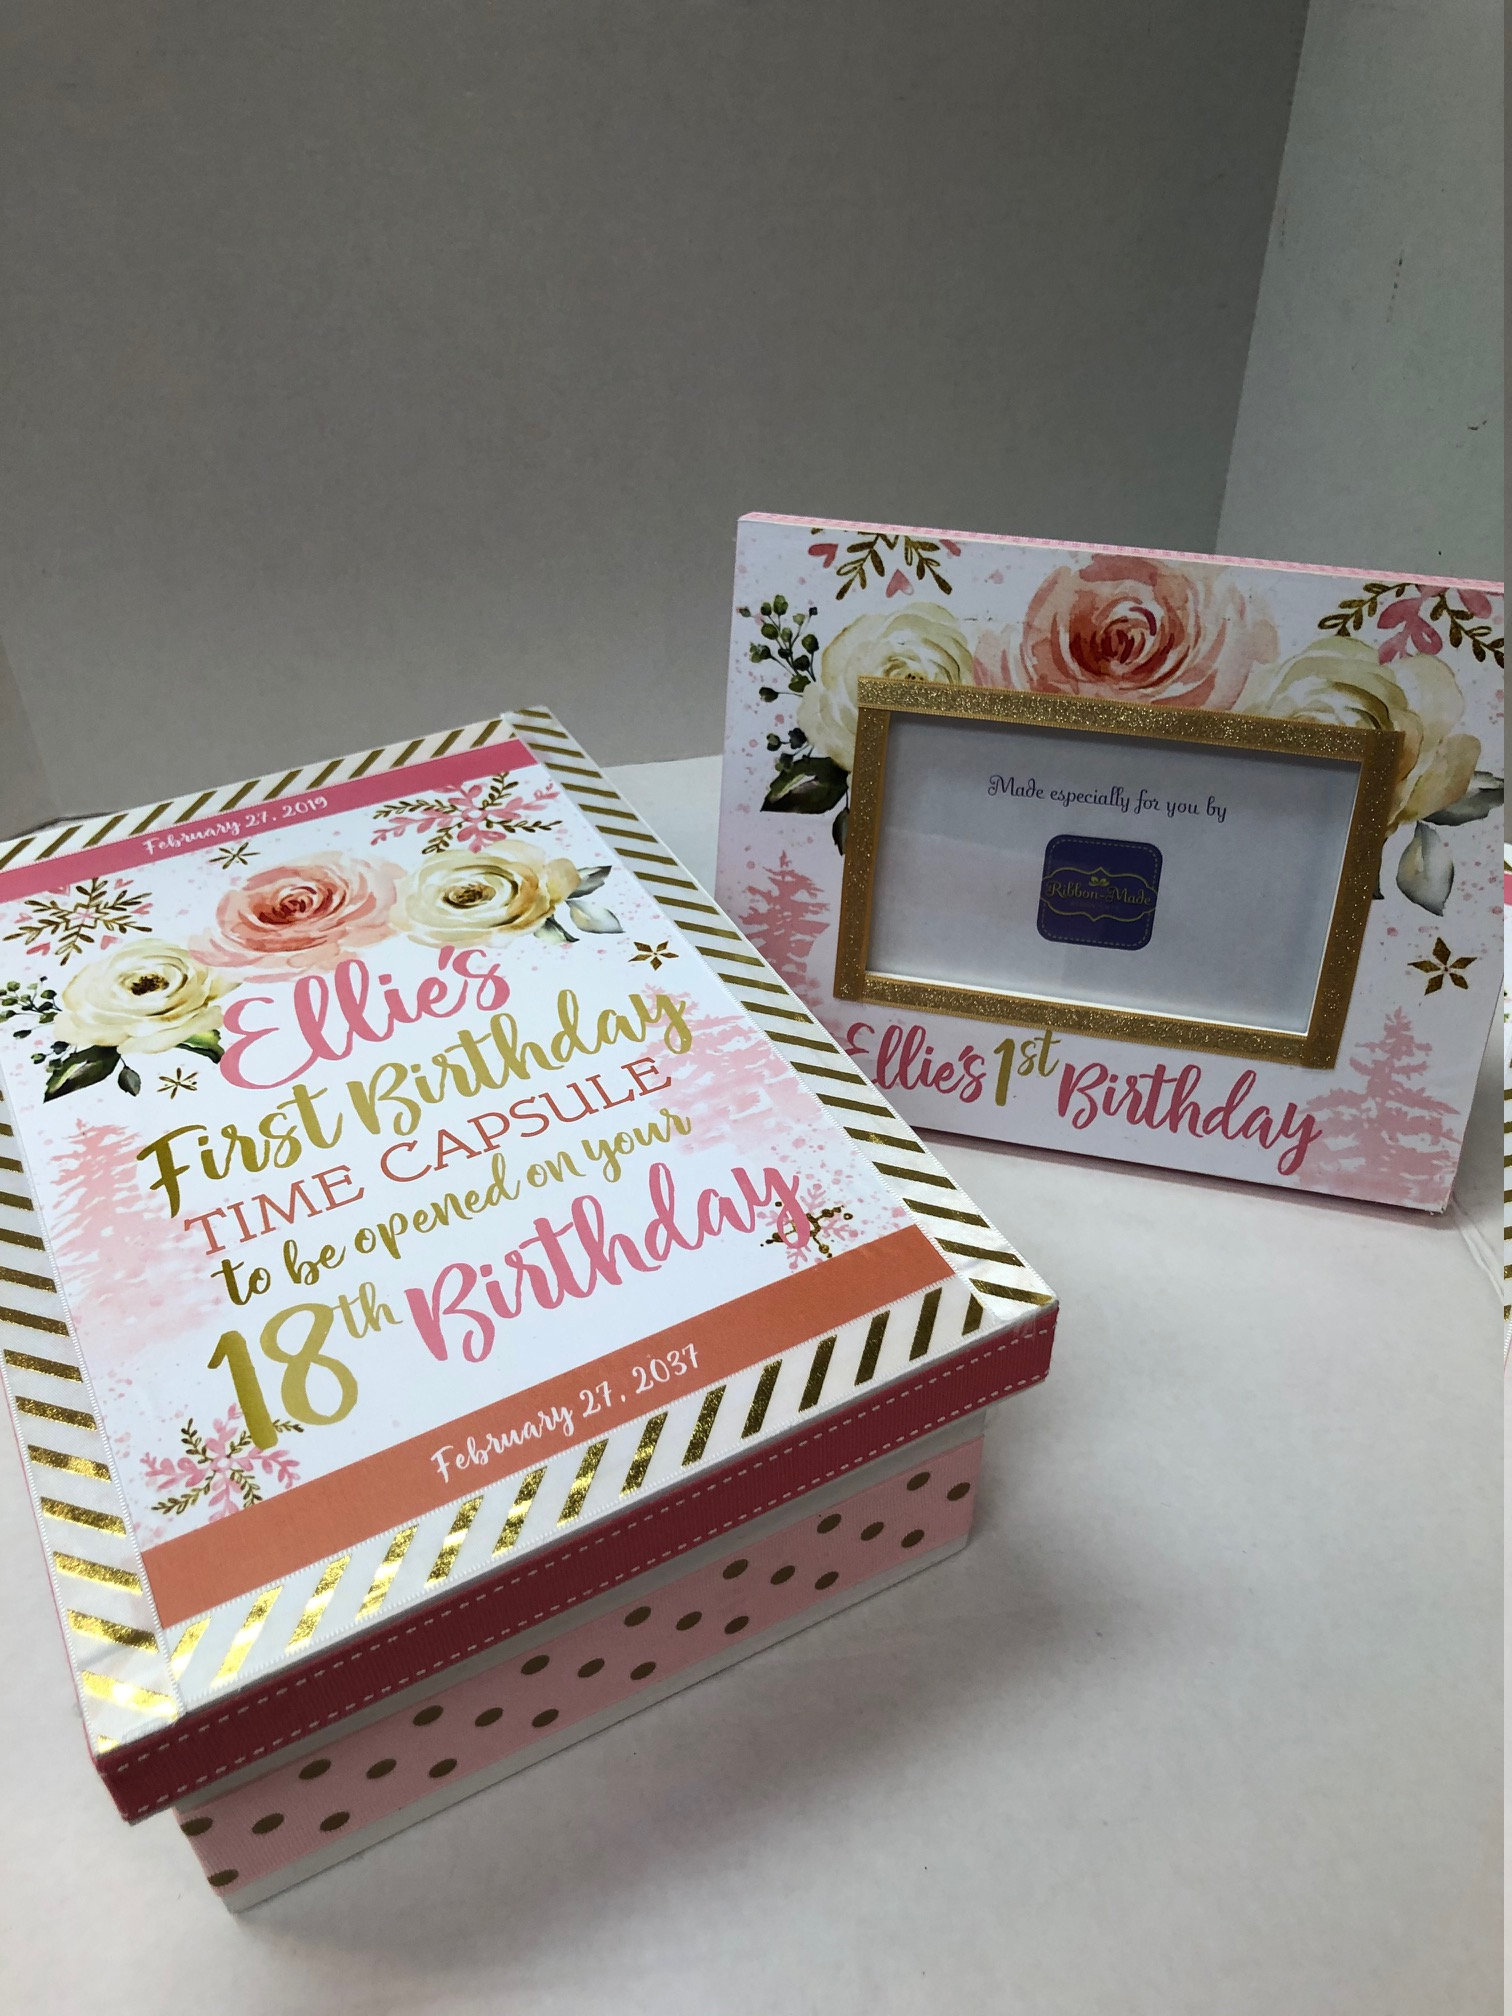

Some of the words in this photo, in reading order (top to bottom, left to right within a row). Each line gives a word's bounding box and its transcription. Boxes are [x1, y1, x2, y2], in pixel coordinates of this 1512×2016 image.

[142, 820, 241, 856] February
[282, 795, 328, 818] 2019
[987, 774, 1044, 799] Made
[1050, 786, 1130, 813] especially
[1134, 789, 1160, 814] for
[1166, 801, 1200, 818] you
[1206, 796, 1227, 823] by
[1048, 880, 1152, 906] Ribbon-Made
[219, 945, 512, 1090] Ellie's
[136, 1084, 344, 1219] First
[347, 989, 694, 1136] Birthday
[184, 1164, 365, 1256] TIME
[380, 1056, 673, 1182] CAPSULE
[846, 1021, 986, 1103] Ellie's
[992, 1030, 1062, 1107] 1st
[1057, 1062, 1323, 1176] Birthday
[211, 1257, 272, 1307] to
[282, 1237, 348, 1287] be
[354, 1152, 521, 1261] opened
[526, 1150, 586, 1188] on
[580, 1107, 692, 1183] your
[207, 1280, 403, 1450] 18th
[403, 1161, 812, 1363] Birthday
[430, 1402, 575, 1483] February
[635, 1344, 700, 1392] 2037
